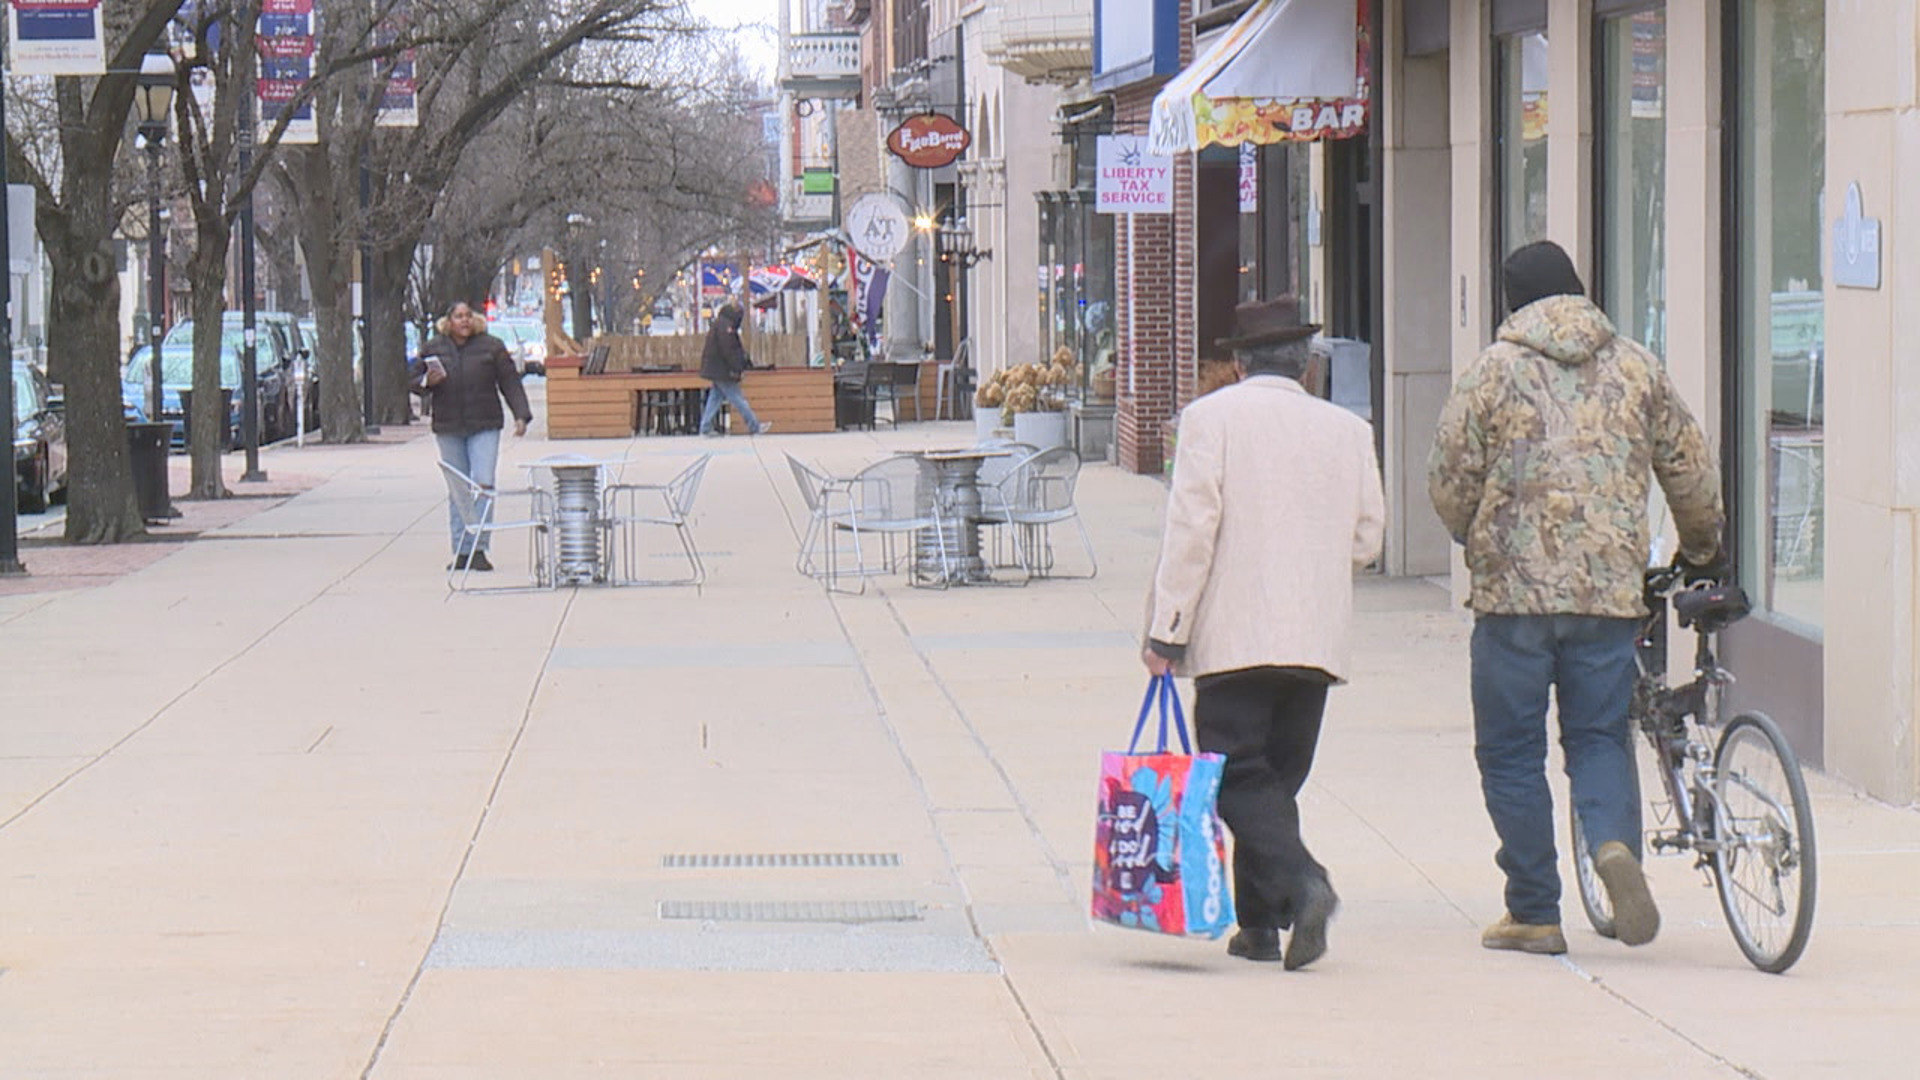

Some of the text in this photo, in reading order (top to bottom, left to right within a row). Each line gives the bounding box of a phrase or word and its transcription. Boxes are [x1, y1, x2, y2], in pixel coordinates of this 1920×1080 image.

[1291, 104, 1365, 131] BAR
[1103, 167, 1167, 179] LIBERTY
[1119, 179, 1150, 191] TAX
[1101, 192, 1166, 204] SERVICE
[1116, 805, 1137, 819] BE
